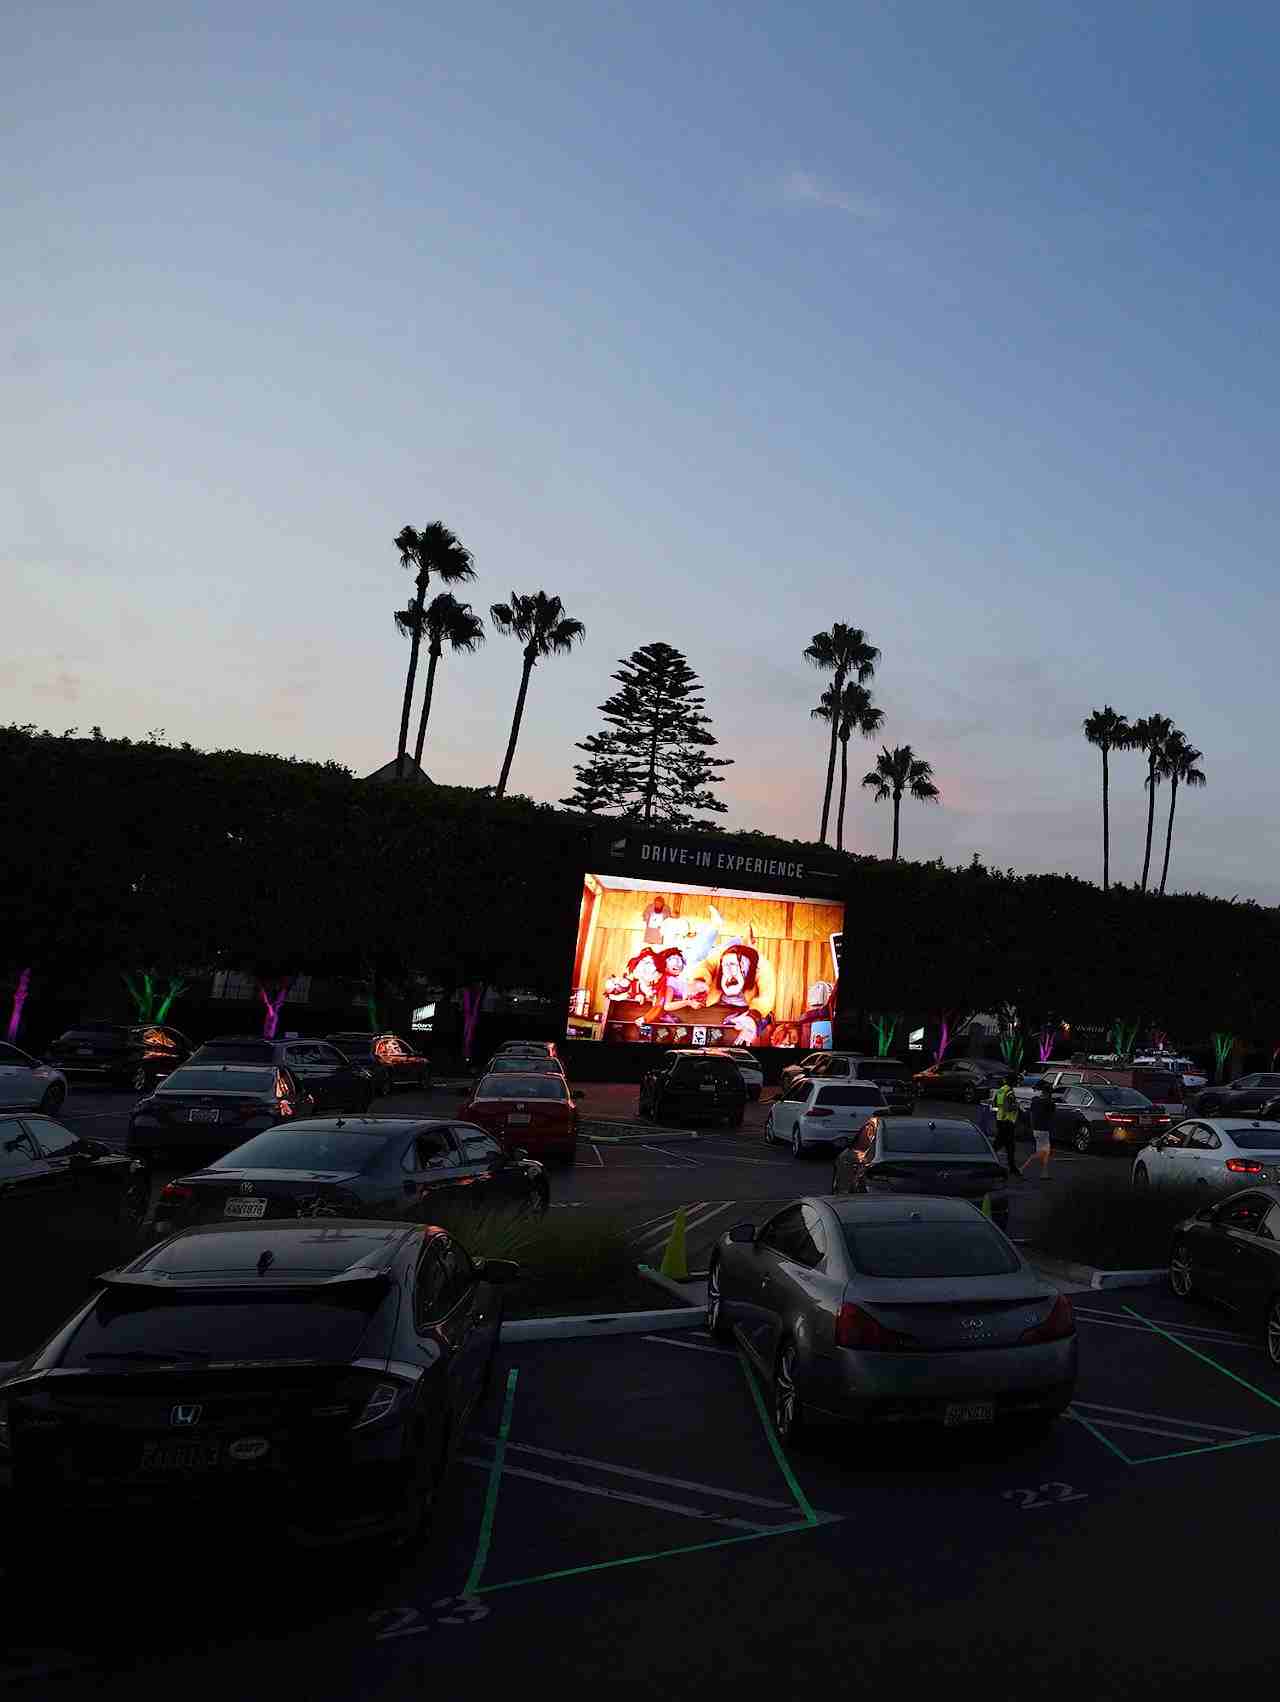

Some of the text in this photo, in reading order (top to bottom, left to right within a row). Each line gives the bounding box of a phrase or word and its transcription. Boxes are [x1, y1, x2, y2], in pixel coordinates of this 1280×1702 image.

[641, 844, 804, 879] DRIVE-IN EXPERIENCE
[1000, 1481, 1089, 1510] 22
[369, 1594, 491, 1640] 23
